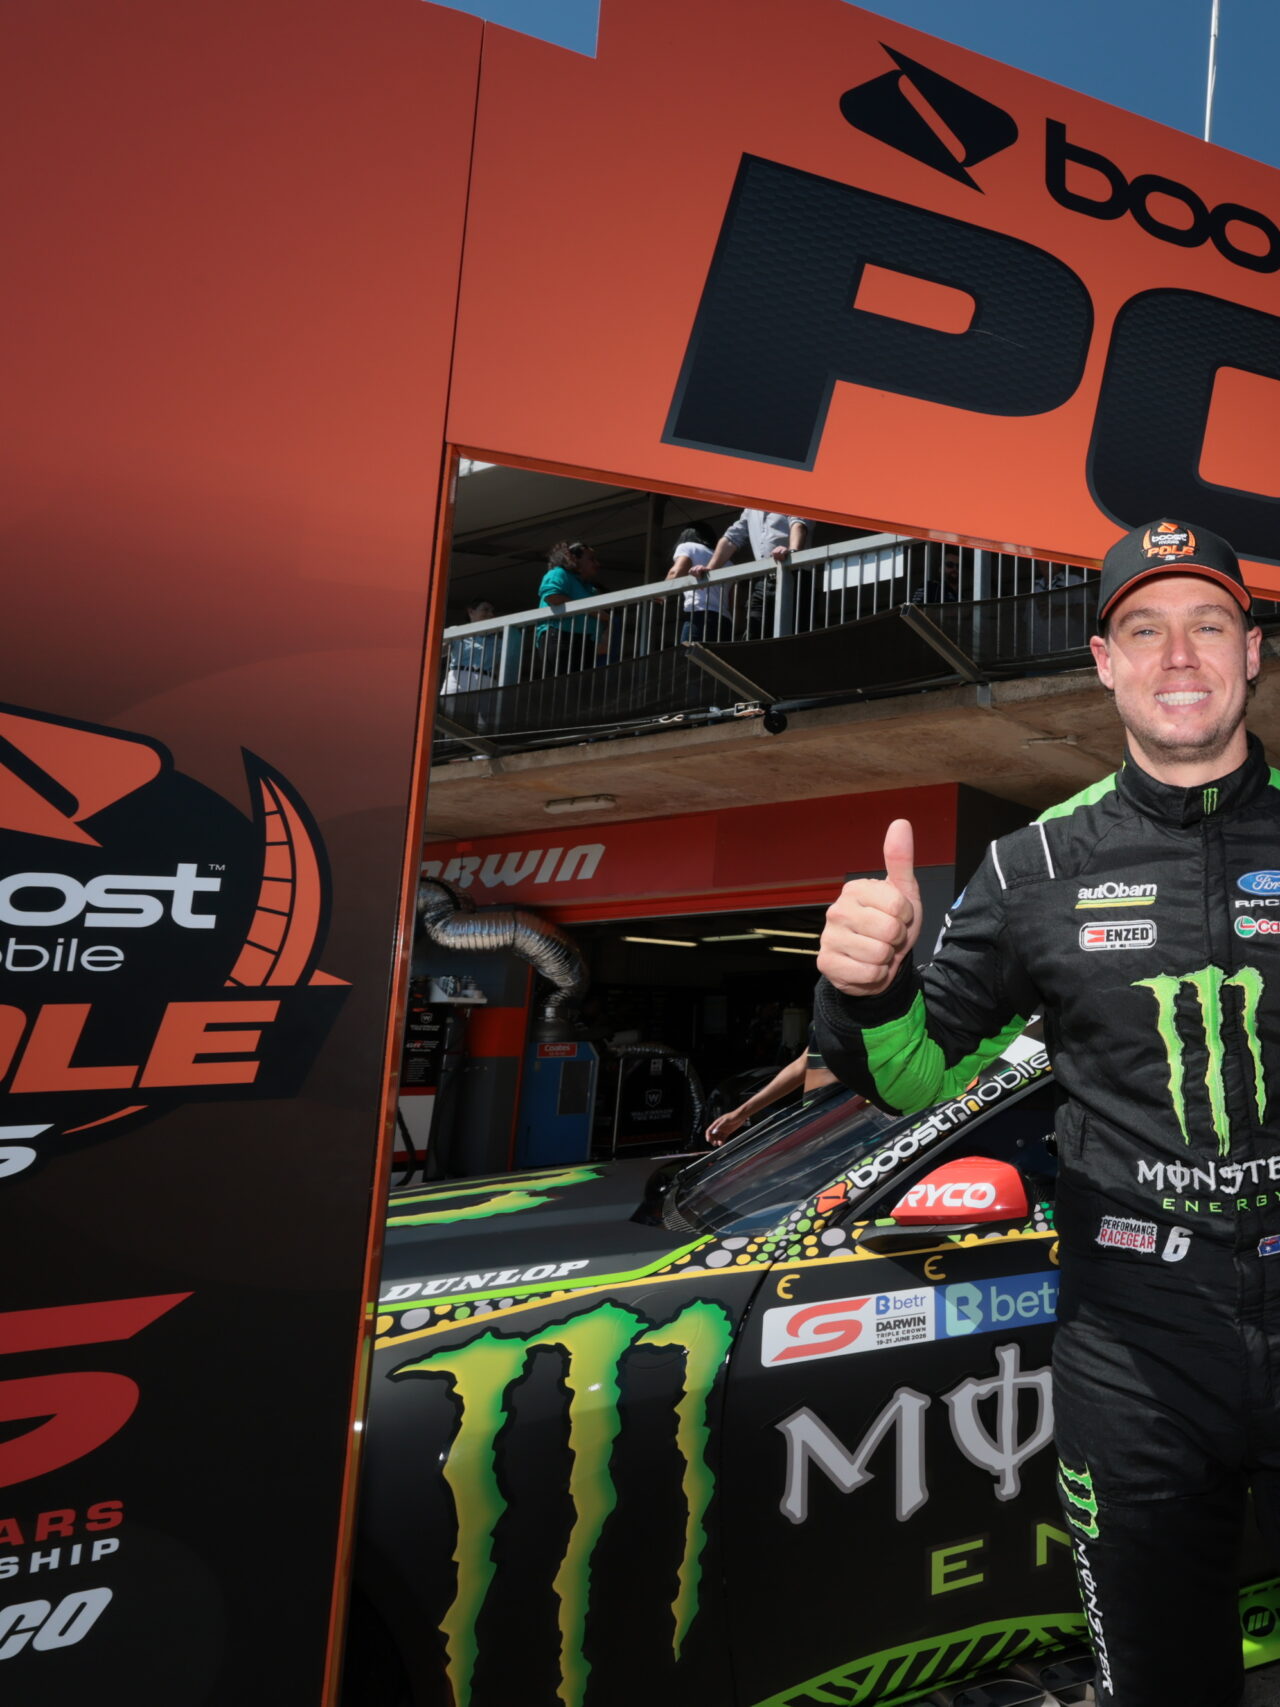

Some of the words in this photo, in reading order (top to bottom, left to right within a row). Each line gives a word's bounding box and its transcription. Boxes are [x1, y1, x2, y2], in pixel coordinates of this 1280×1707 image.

[1151, 533, 1188, 543] boost
[1146, 545, 1196, 558] POLE
[1105, 927, 1150, 942] ENZED
[0, 937, 125, 972] bile
[898, 1182, 996, 1208] RYCO
[1102, 1218, 1156, 1236] PERFORMANCE
[1100, 1228, 1155, 1249] RACEGEAR
[1161, 1226, 1194, 1263] 6
[377, 1259, 590, 1302] DUNLOP
[893, 1293, 926, 1311] betr
[990, 1281, 1060, 1322] bet
[876, 1315, 926, 1333] DARWIN
[876, 1331, 900, 1339] TRIPLE
[902, 1327, 927, 1335] CROWN
[876, 1338, 893, 1346] 19-21
[893, 1335, 910, 1344] JUNE
